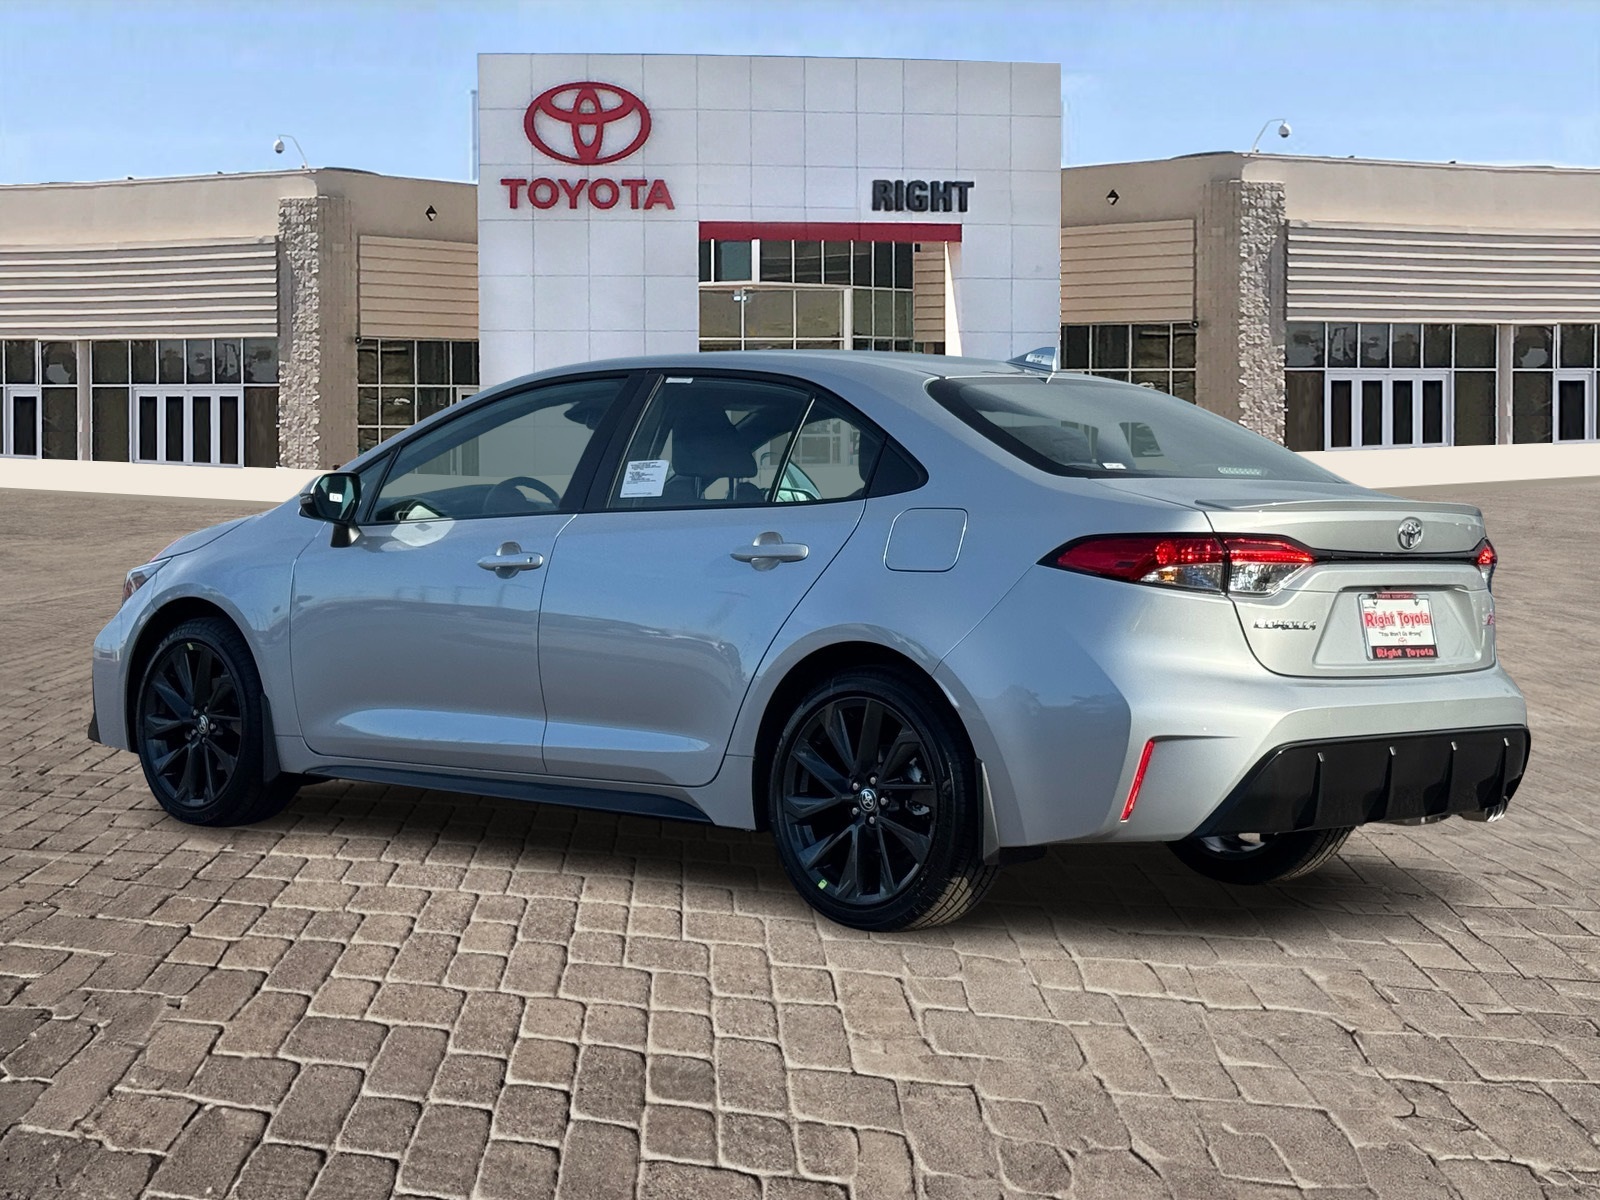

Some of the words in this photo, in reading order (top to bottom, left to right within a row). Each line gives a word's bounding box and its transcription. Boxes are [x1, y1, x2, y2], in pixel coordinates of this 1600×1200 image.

[501, 178, 675, 210] TOYOTA
[871, 179, 975, 213] RIGHT
[1364, 611, 1395, 629] Right
[1396, 611, 1430, 628] Toyota
[1376, 647, 1402, 659] Right
[1405, 647, 1434, 658] Toyota
